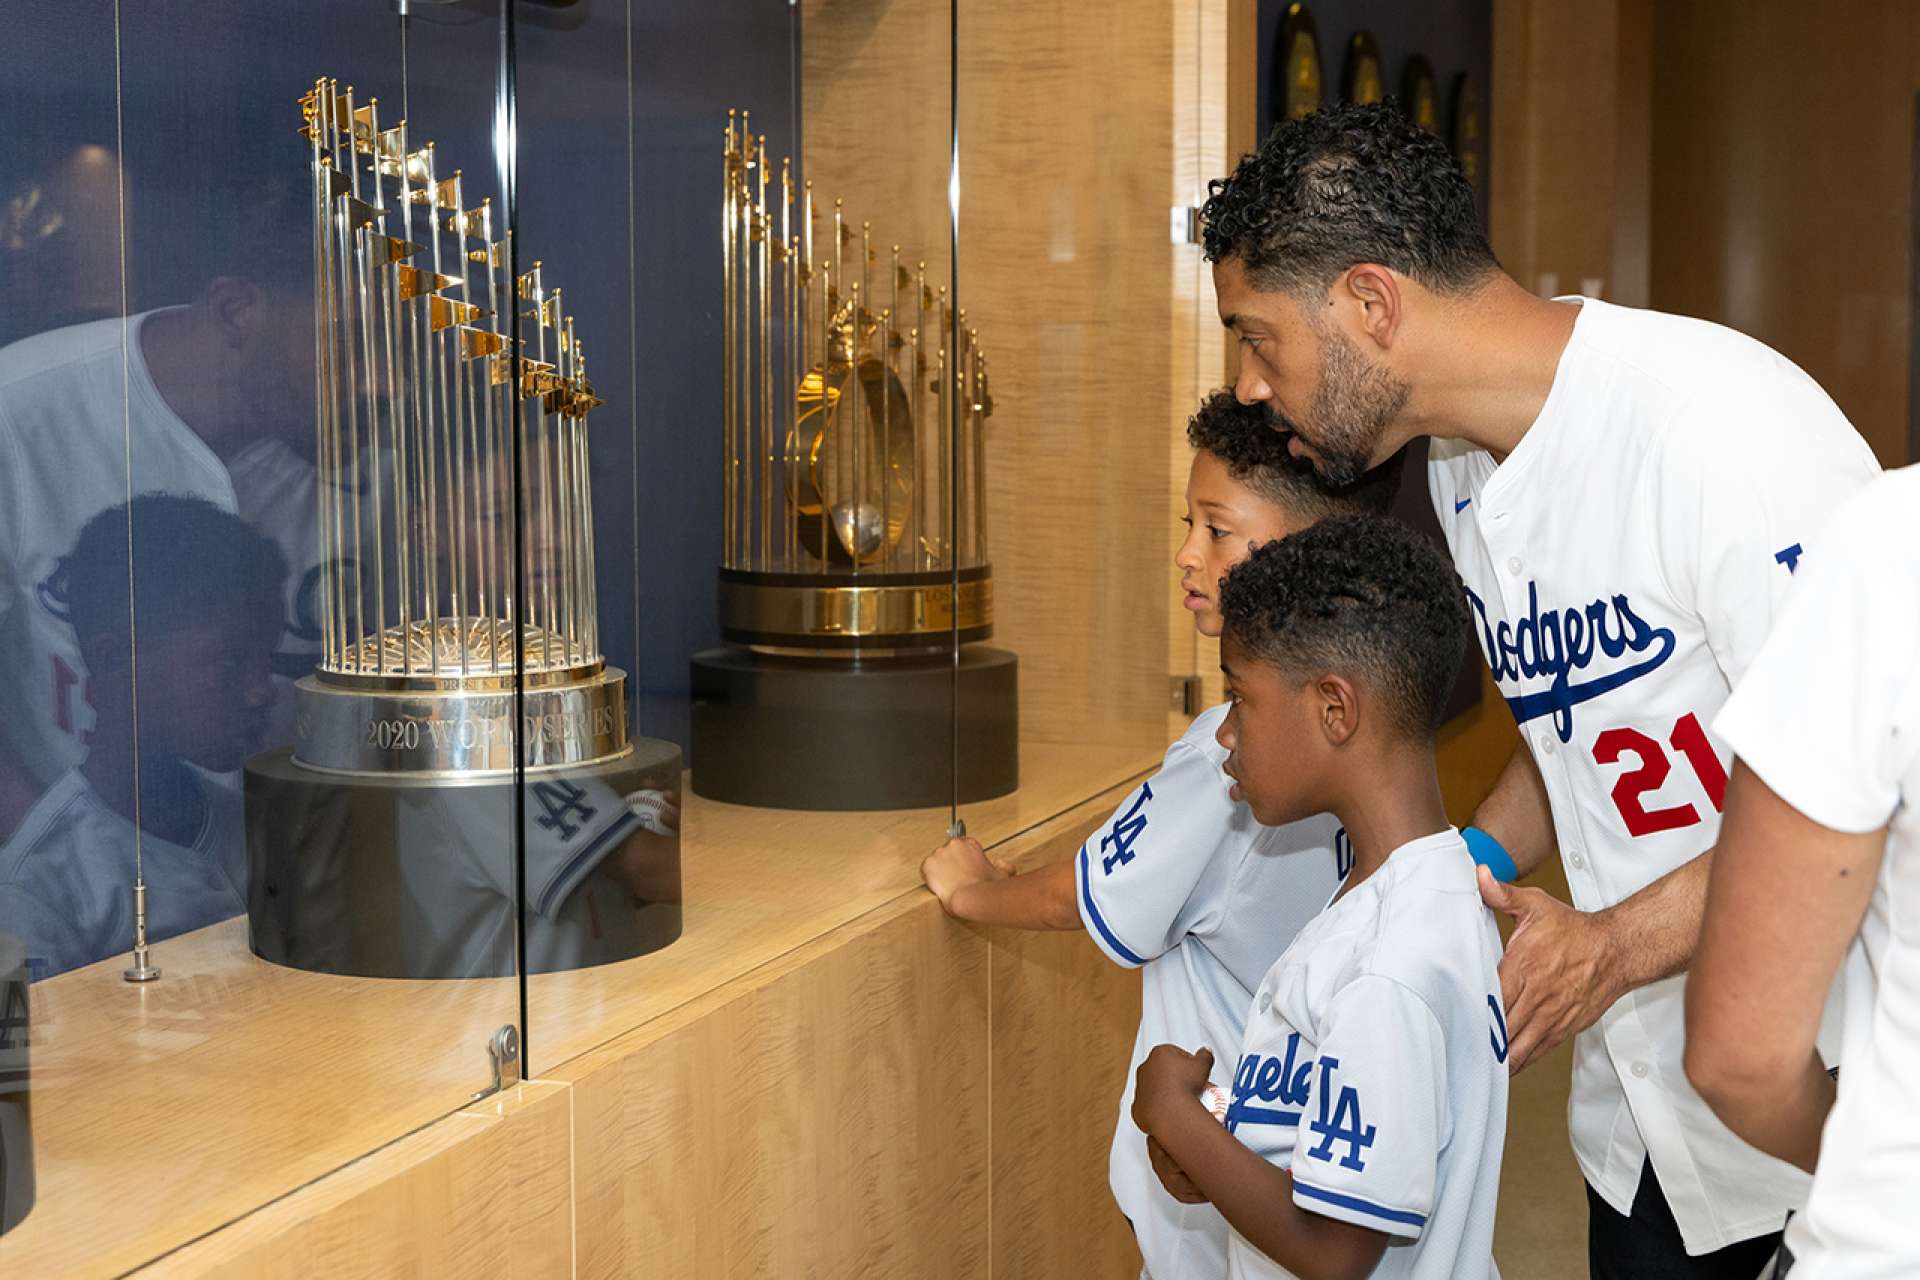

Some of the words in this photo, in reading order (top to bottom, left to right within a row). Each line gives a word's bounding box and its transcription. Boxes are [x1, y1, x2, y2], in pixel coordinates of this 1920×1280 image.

[1463, 580, 1676, 743] Dodgers
[367, 719, 420, 750] 2020
[421, 717, 535, 750] WORD
[543, 705, 616, 743] SERIES
[1592, 712, 1729, 837] 21
[1100, 781, 1154, 877] LA
[1225, 1030, 1314, 1136] gele
[1307, 1054, 1377, 1173] LA
